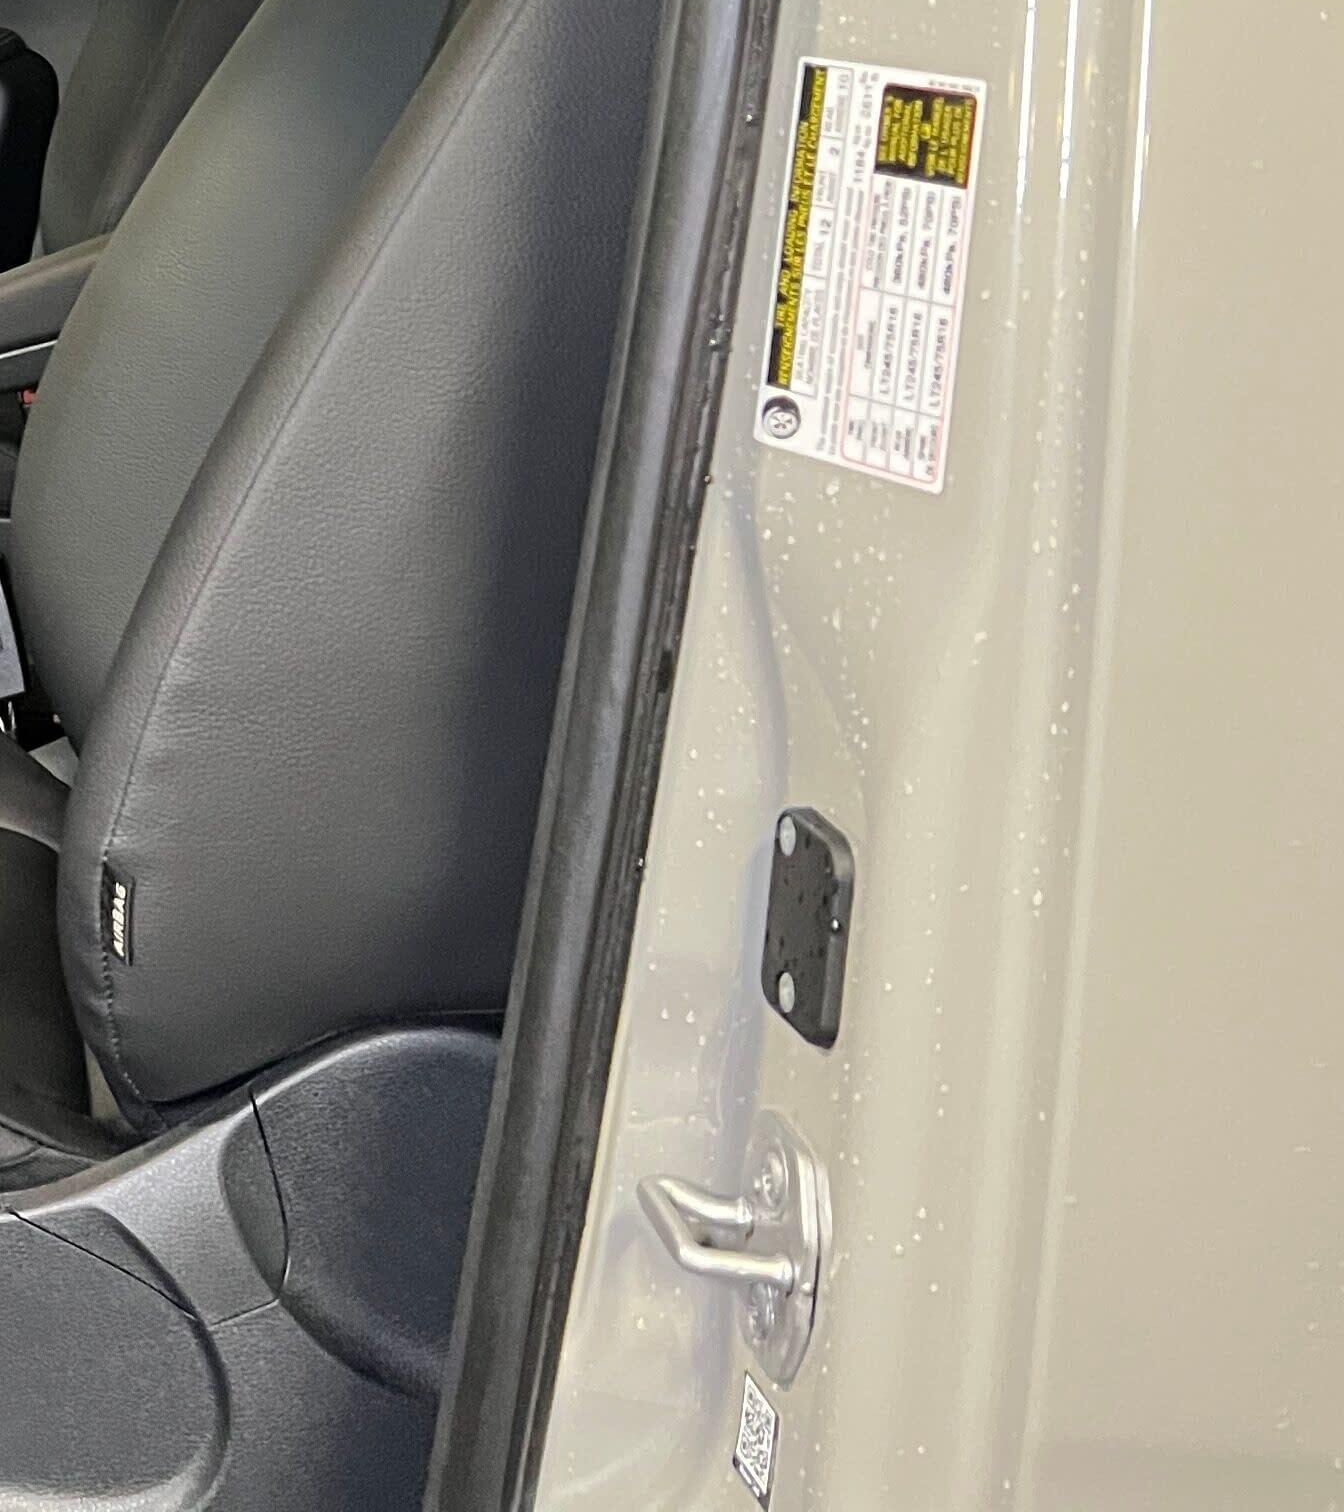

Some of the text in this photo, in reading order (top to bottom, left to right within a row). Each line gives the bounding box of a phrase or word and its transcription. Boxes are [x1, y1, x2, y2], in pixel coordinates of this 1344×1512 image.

[788, 120, 808, 202] INFORMATION
[782, 209, 797, 263] LOADING
[778, 268, 790, 296] AND
[111, 881, 127, 958] AIRBAG
